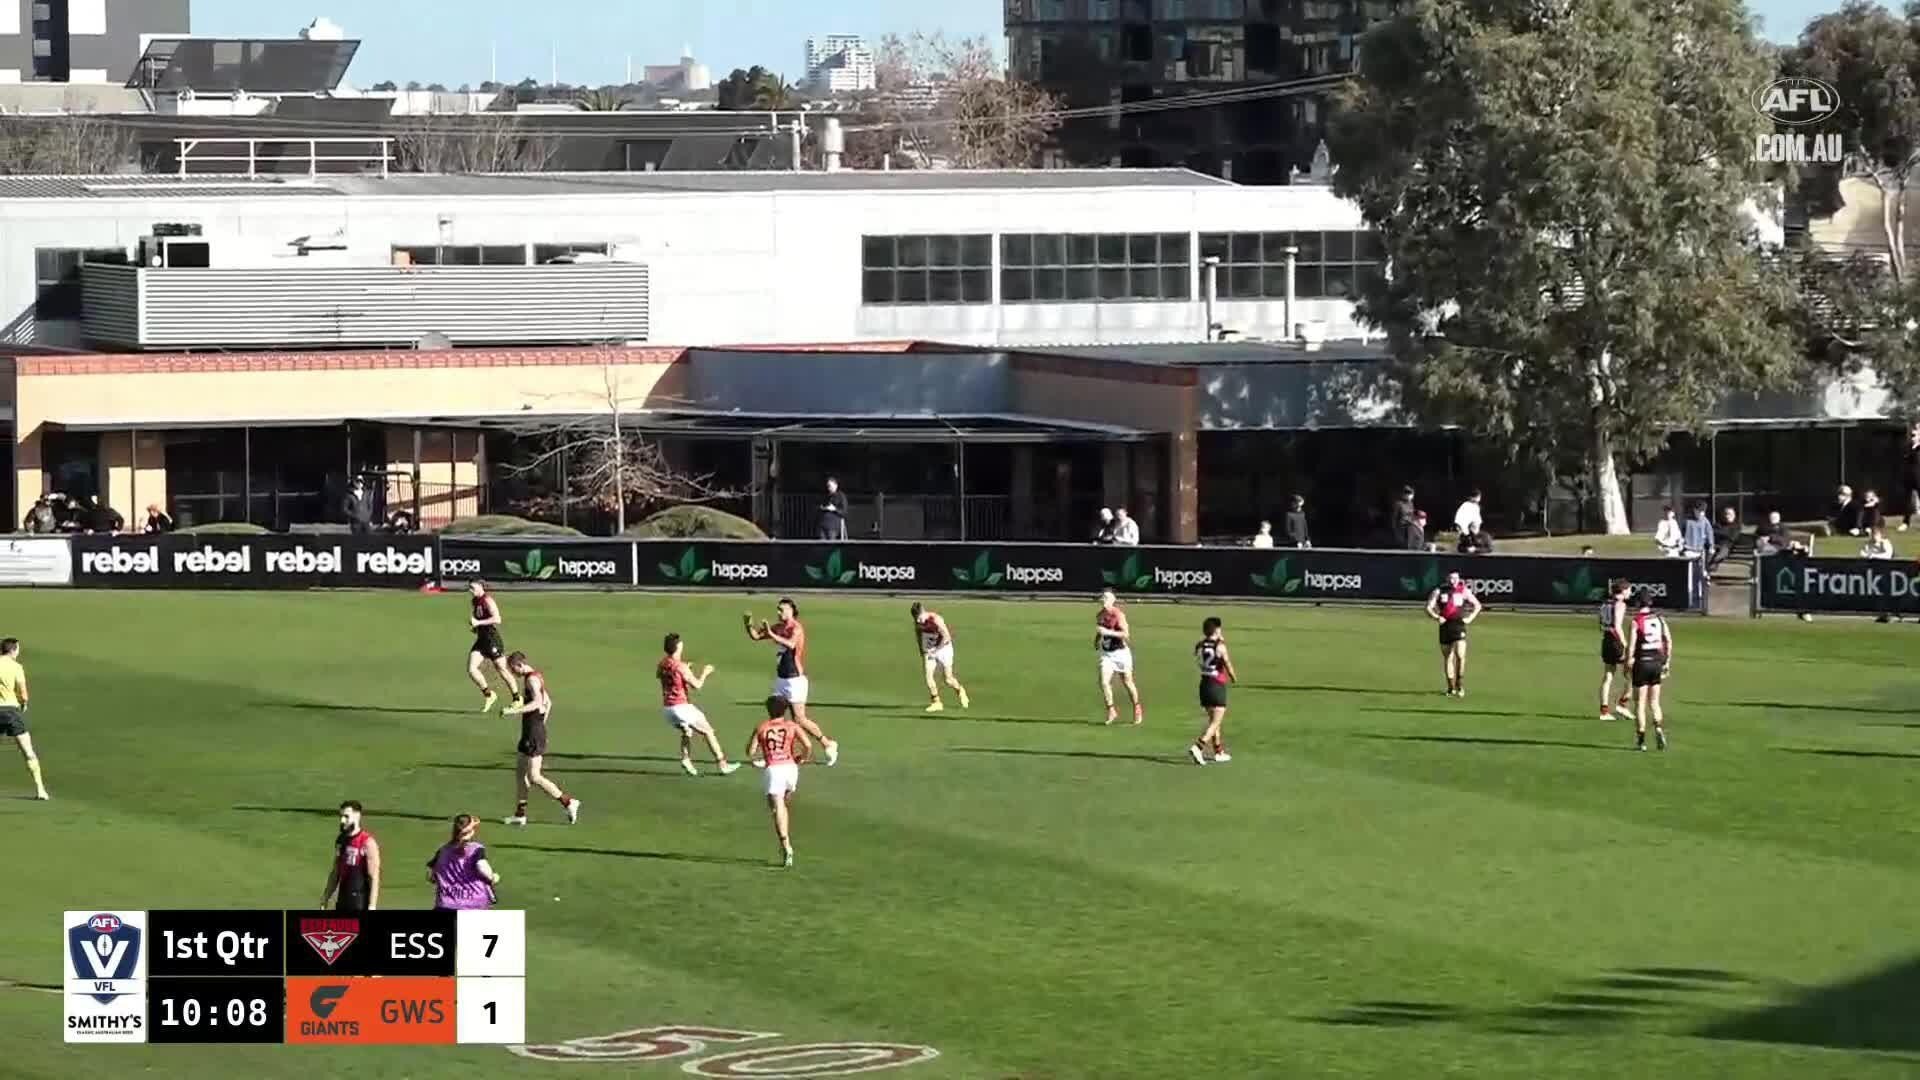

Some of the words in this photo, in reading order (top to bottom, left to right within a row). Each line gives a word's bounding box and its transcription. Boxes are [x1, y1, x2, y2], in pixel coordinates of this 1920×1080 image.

[82, 546, 159, 573] rebel
[174, 545, 251, 573] rebel
[266, 545, 341, 573] rebel
[357, 546, 432, 574] rebel
[440, 559, 480, 576] ppsa
[559, 556, 616, 577] happsa
[712, 560, 768, 580] happsa
[858, 561, 915, 581] happsa
[1006, 563, 1063, 583] happsa
[1154, 566, 1212, 586] happsa
[1304, 569, 1361, 589] happsa
[1459, 578, 1513, 596] appsa
[1803, 568, 1883, 596] Frank
